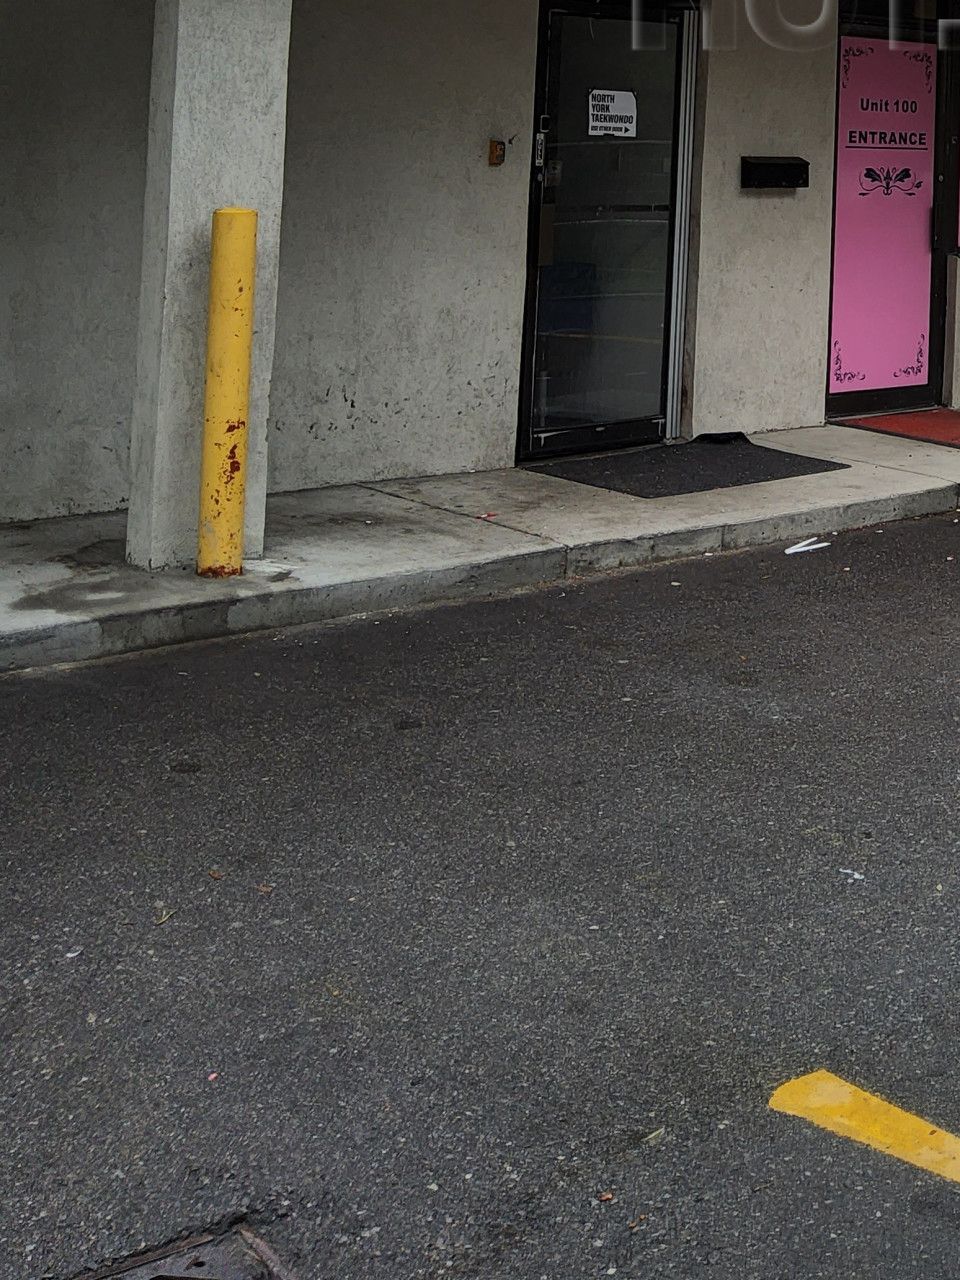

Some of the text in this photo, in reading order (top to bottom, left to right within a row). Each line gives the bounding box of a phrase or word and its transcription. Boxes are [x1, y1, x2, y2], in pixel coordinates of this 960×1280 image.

[591, 93, 615, 104] NORTH
[591, 103, 611, 113] YORK
[860, 98, 918, 113] Unit 100
[591, 113, 634, 124] TAEKWONDO
[848, 130, 927, 146] ENTRANCE
